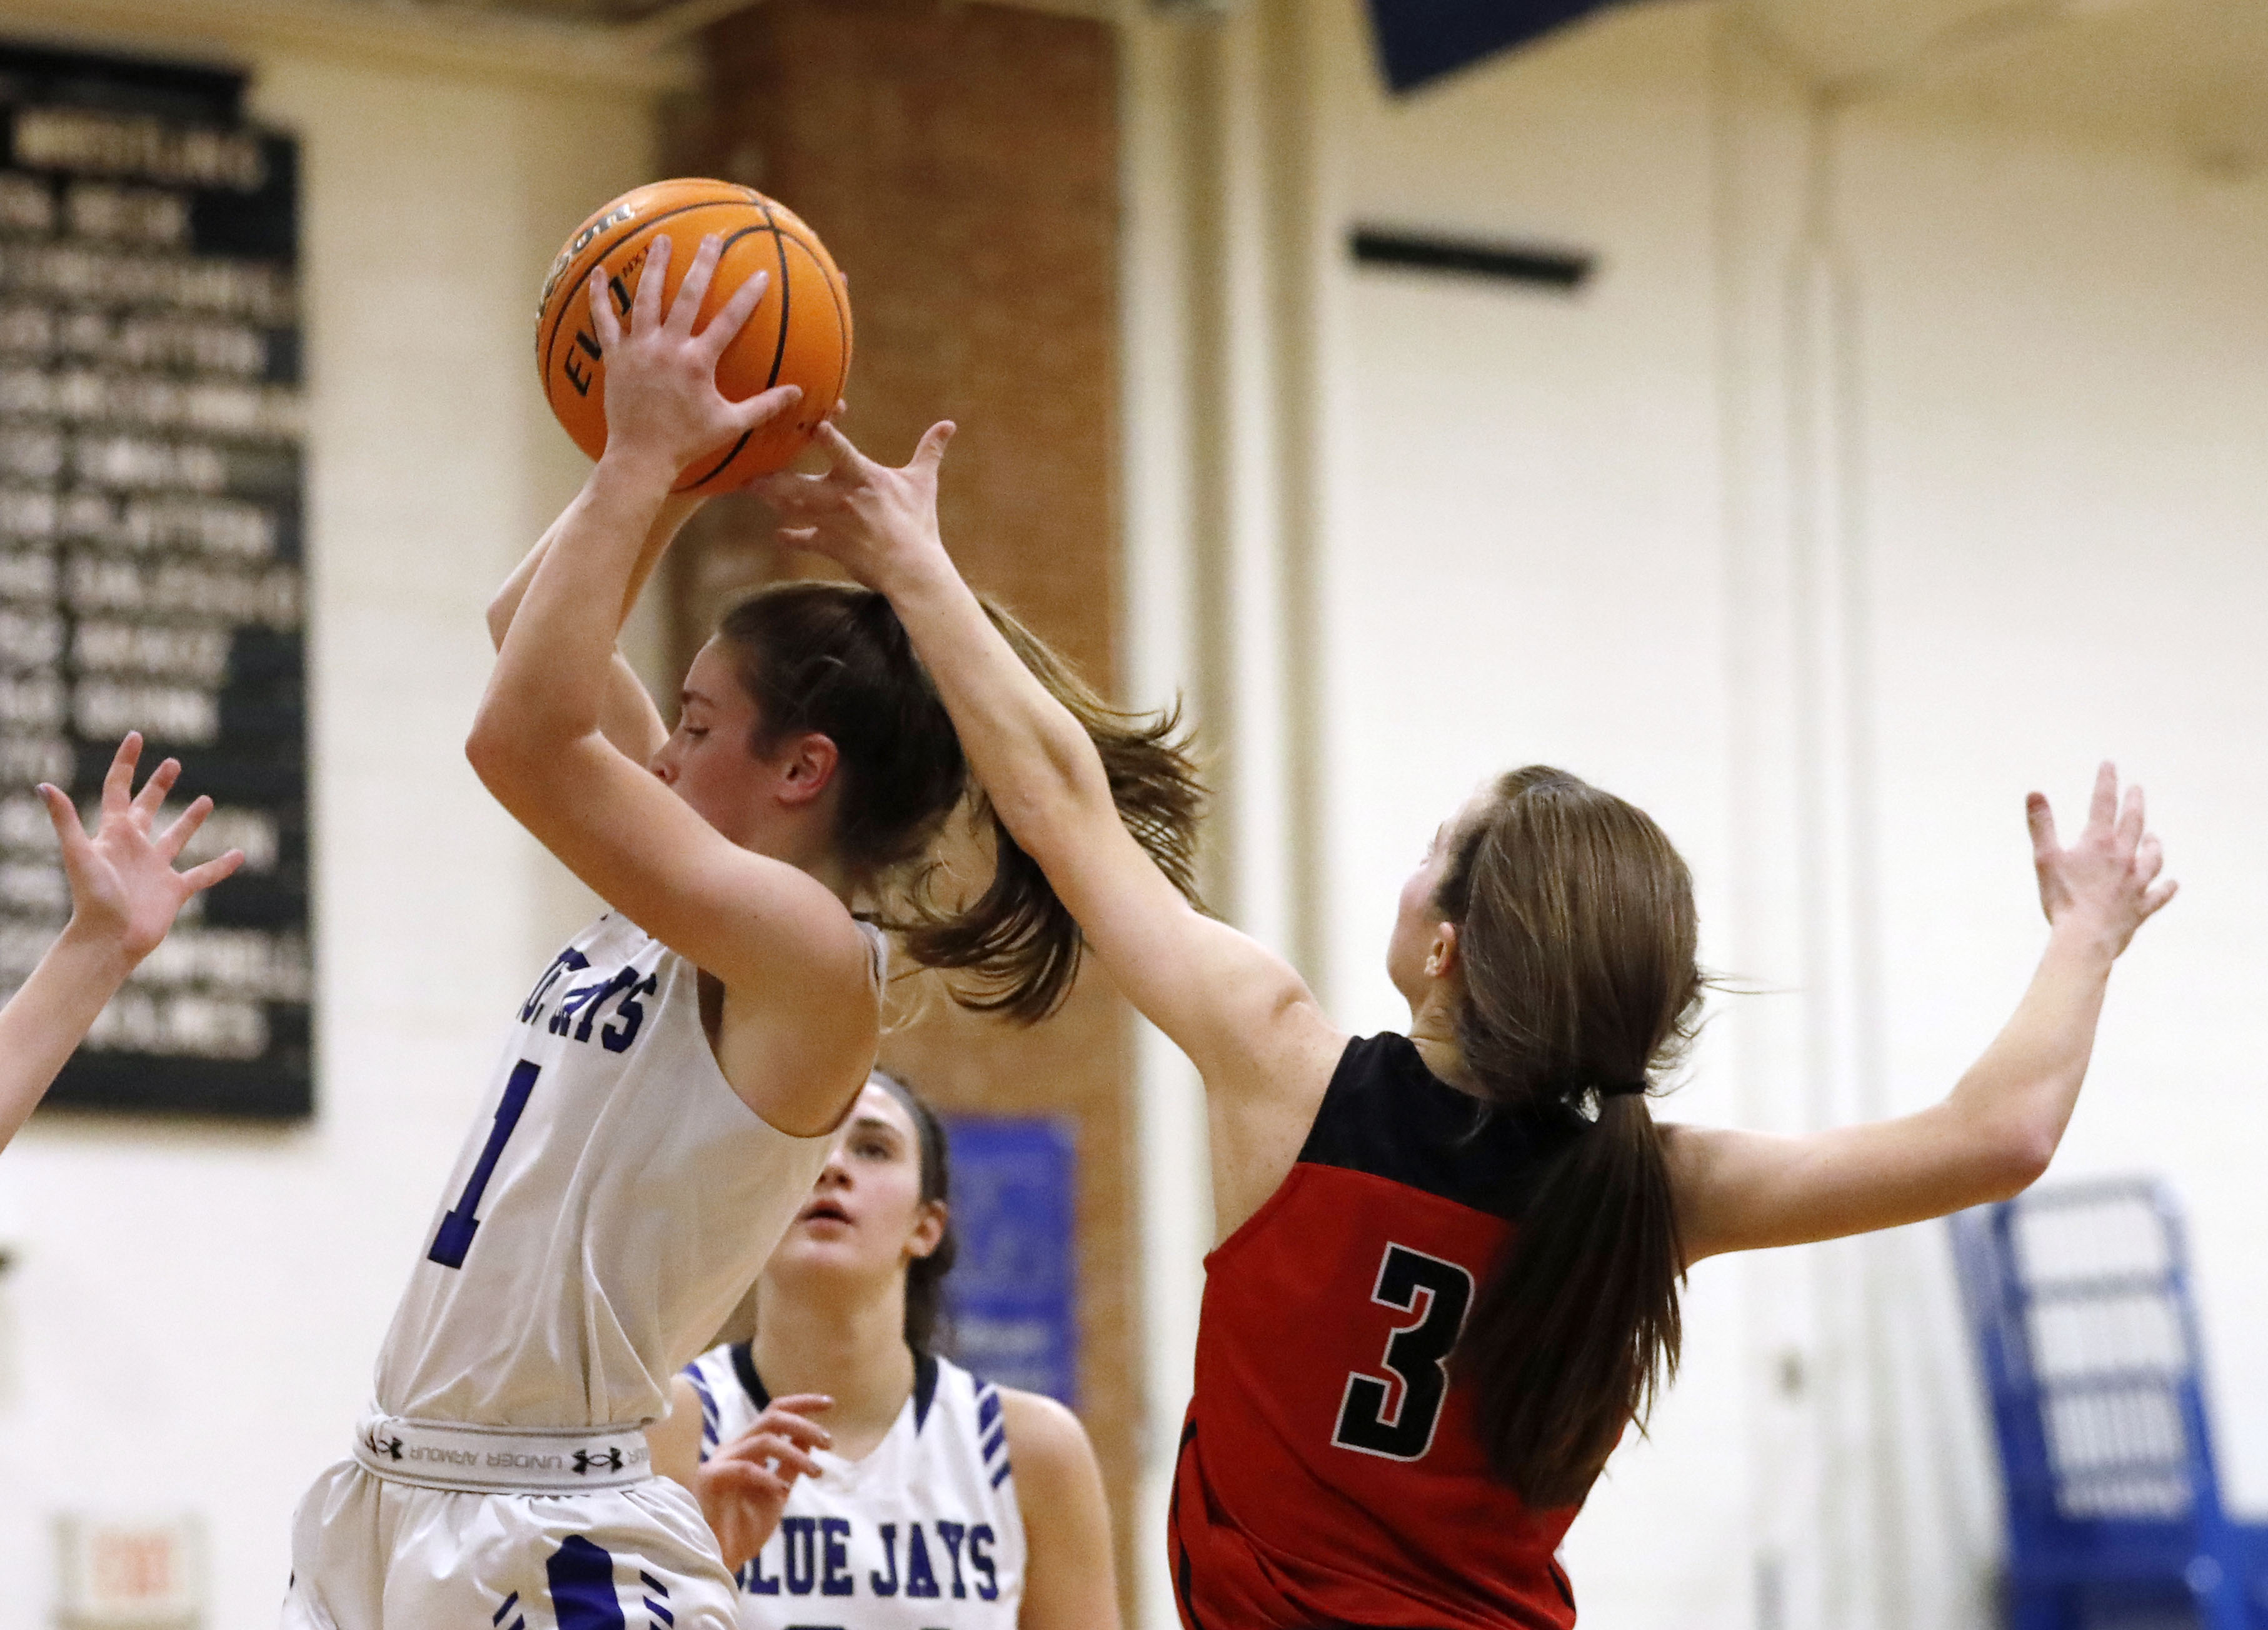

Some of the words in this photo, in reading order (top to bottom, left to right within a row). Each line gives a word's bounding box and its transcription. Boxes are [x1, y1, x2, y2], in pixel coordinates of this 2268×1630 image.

[428, 1059, 542, 1269] 1
[1330, 1241, 1475, 1462] 3
[486, 1451, 563, 1470] UNDER
[734, 1516, 853, 1596] LUE
[871, 1519, 999, 1601] JAYS
